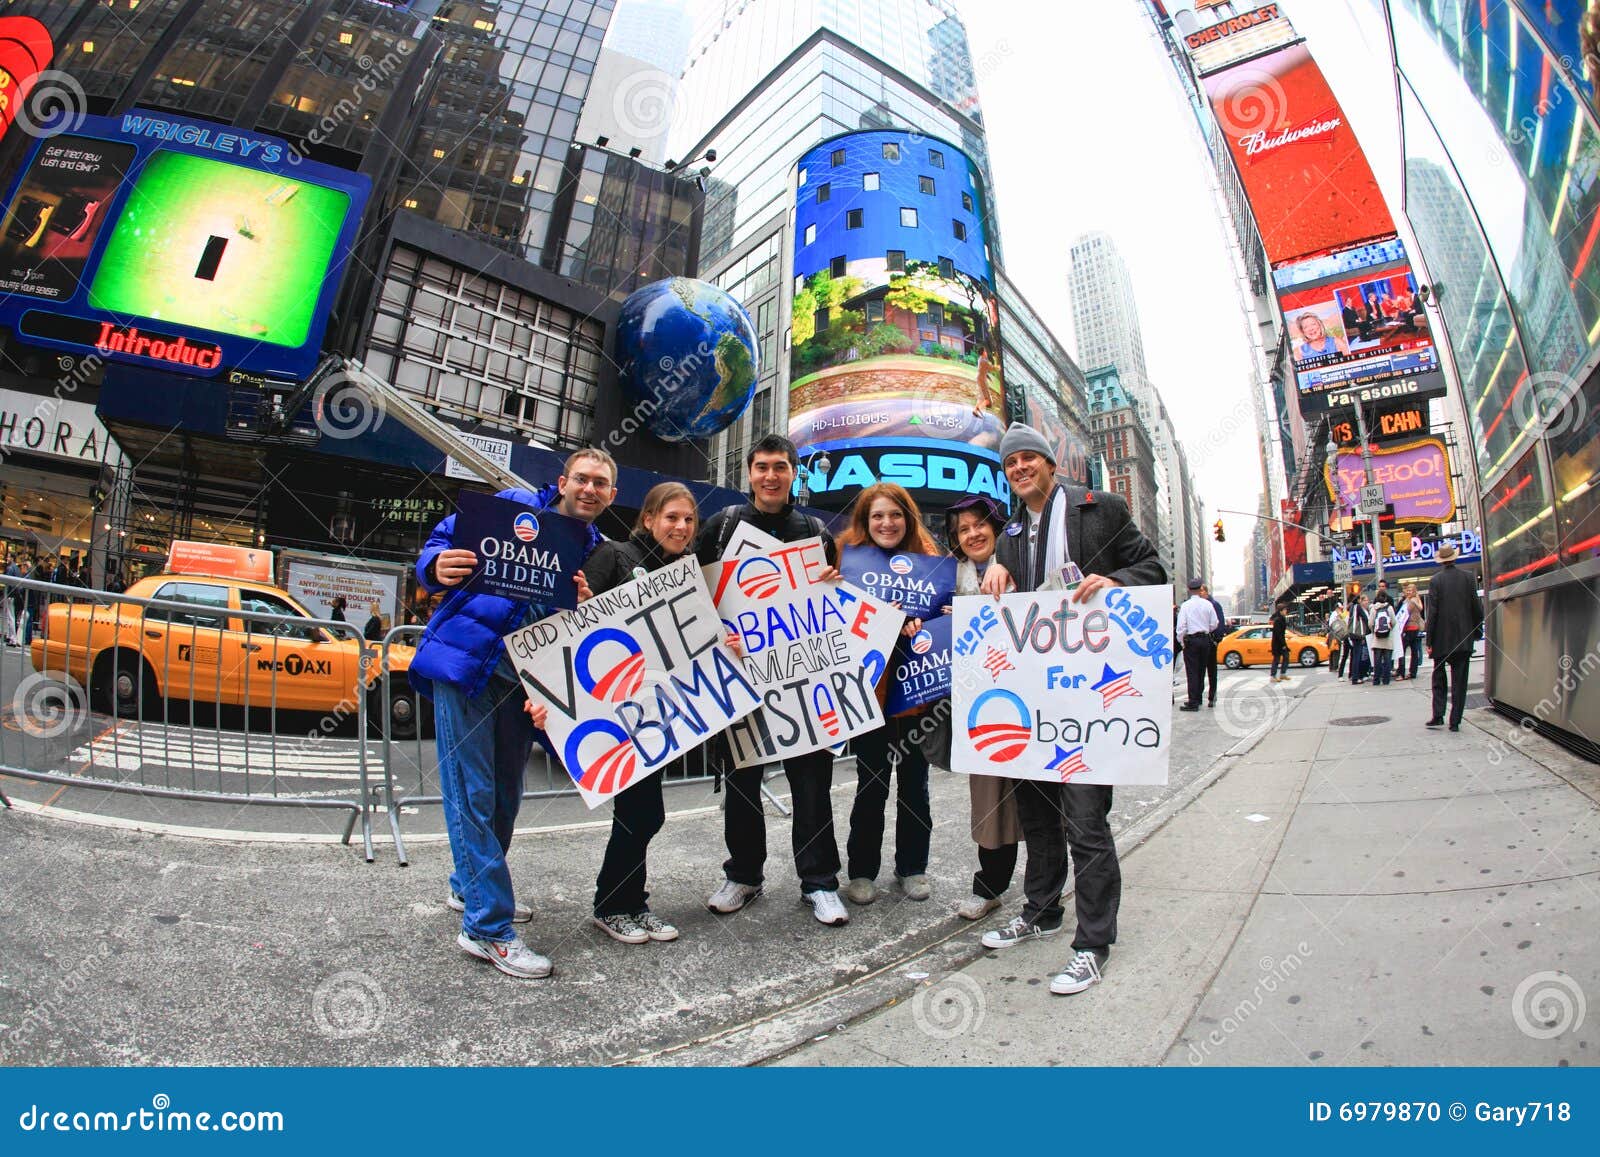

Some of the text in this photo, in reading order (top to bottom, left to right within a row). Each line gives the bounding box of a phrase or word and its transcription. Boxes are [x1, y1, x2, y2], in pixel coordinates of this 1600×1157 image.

[1186, 4, 1280, 49] CHEVROLET
[121, 114, 283, 163] WRIGLEY'S
[1238, 117, 1342, 155] Budweiser
[1327, 379, 1419, 407] Paasonic
[812, 413, 889, 432] HD-LICIOUS
[1380, 410, 1422, 435] ICAHN
[792, 453, 1011, 516] NASDAQ
[1363, 498, 1383, 508] TURNS
[1367, 488, 1377, 497] NO
[480, 536, 562, 573] OBAMA
[484, 559, 556, 589] BIDEN
[862, 571, 937, 595] OBAMA
[511, 563, 697, 659] GOOD MORNING AMERICA!
[866, 586, 932, 607] BIDEN
[1001, 599, 1110, 654] Vote
[1104, 588, 1173, 670] Change
[285, 653, 331, 675] TAXI
[520, 586, 719, 721] VOTE
[742, 629, 851, 686] MAKE
[896, 649, 952, 682] OBAM
[902, 665, 952, 695] BIDE
[1047, 665, 1088, 689] For
[564, 646, 763, 795] OBAMA
[730, 665, 876, 763] HISTORY
[968, 688, 1160, 763] Obama
